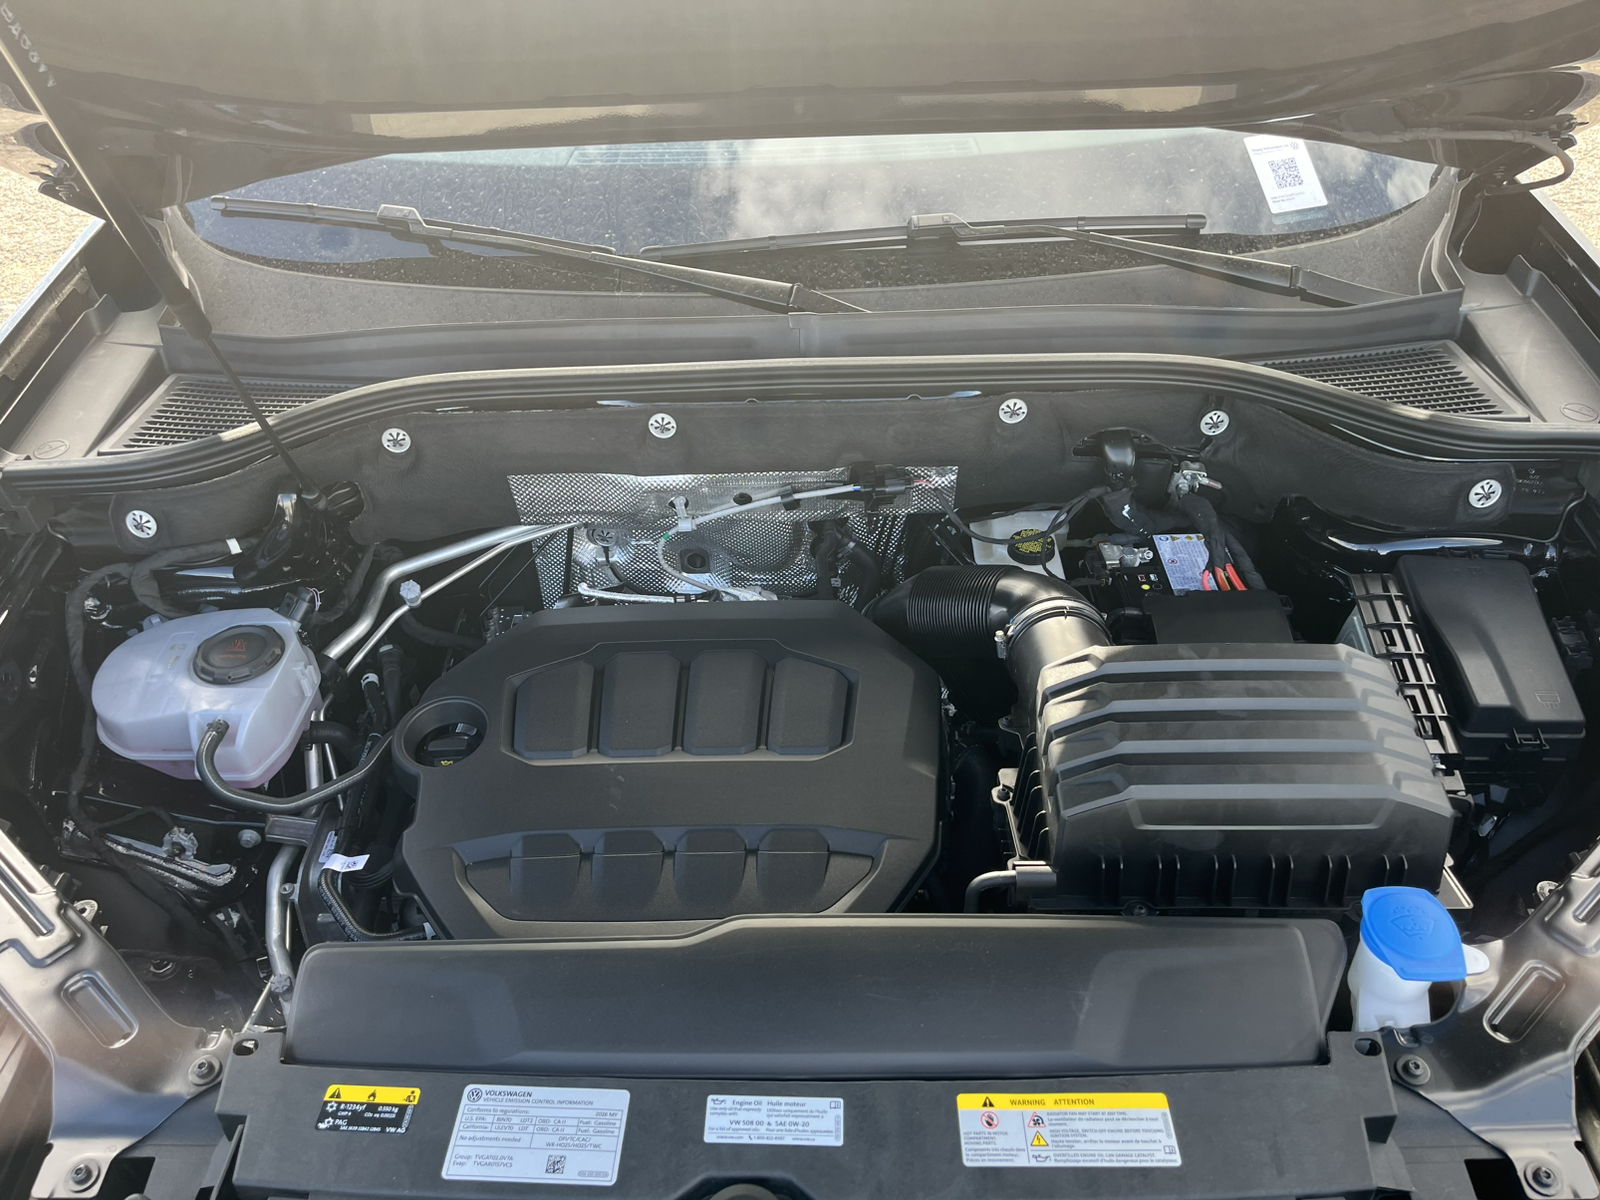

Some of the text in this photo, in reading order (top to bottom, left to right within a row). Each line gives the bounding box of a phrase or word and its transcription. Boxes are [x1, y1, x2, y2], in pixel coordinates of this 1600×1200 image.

[732, 1099, 753, 1107] Engine
[339, 1103, 367, 1112] R-1234yf
[498, 1108, 530, 1116] regulations:
[467, 1135, 501, 1143] adjustments
